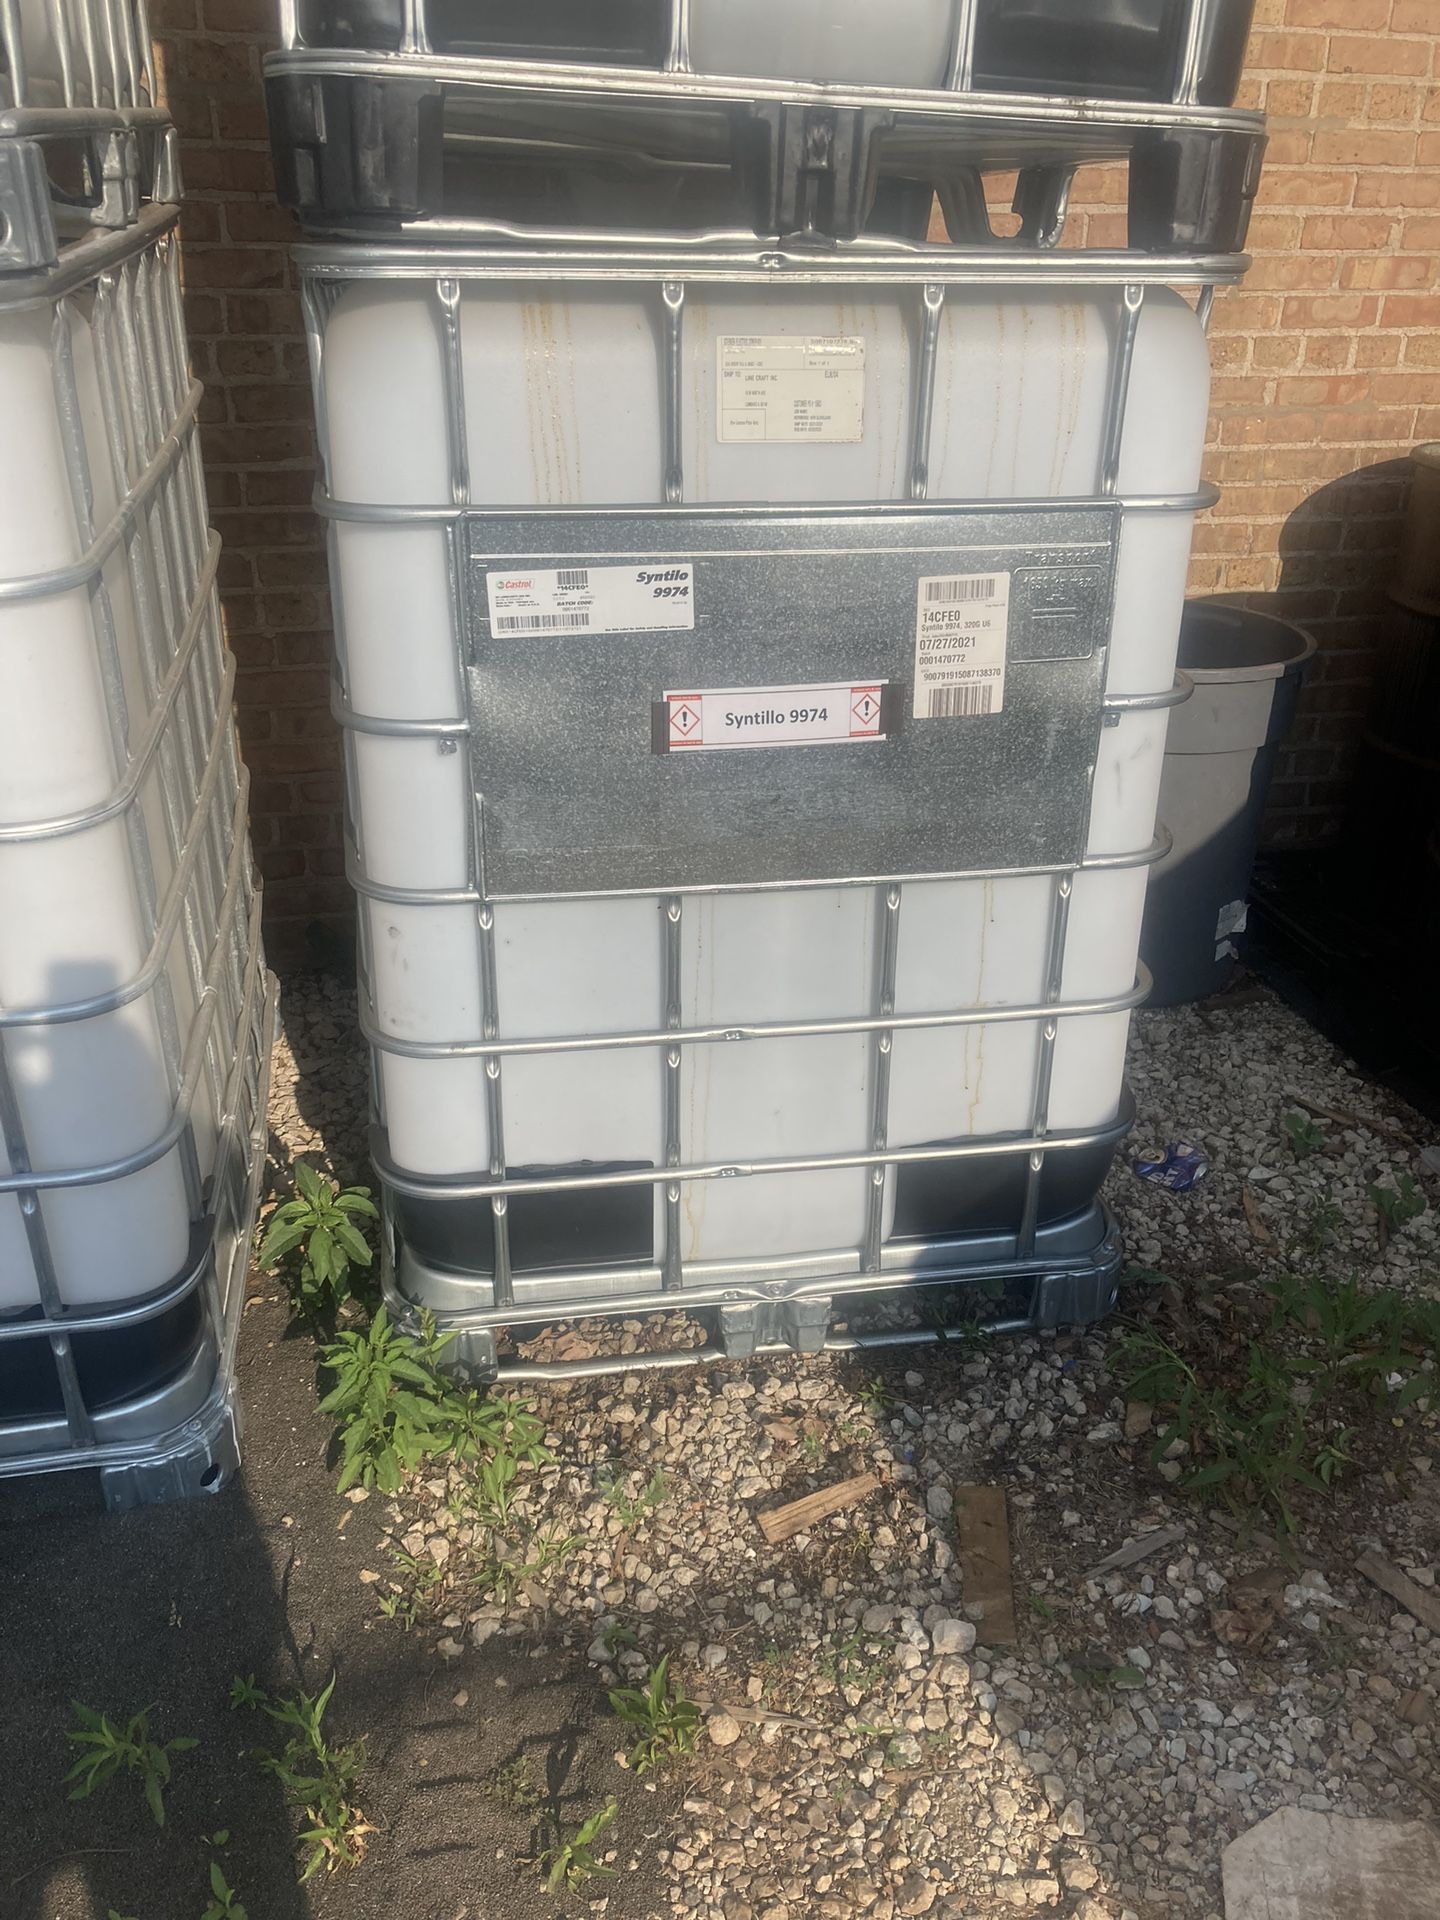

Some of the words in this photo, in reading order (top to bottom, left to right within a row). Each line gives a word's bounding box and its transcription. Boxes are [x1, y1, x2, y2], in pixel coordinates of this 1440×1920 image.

[636, 570, 689, 585] Syntilo
[503, 579, 533, 590] Castrol
[653, 586, 690, 598] 9974
[922, 609, 961, 624] 14CFE0
[920, 624, 944, 633] Syntilo
[919, 636, 976, 651] 07/27/2021
[918, 654, 966, 666] 0001470772
[725, 710, 785, 729] Syntillo
[789, 708, 829, 723] 9974
